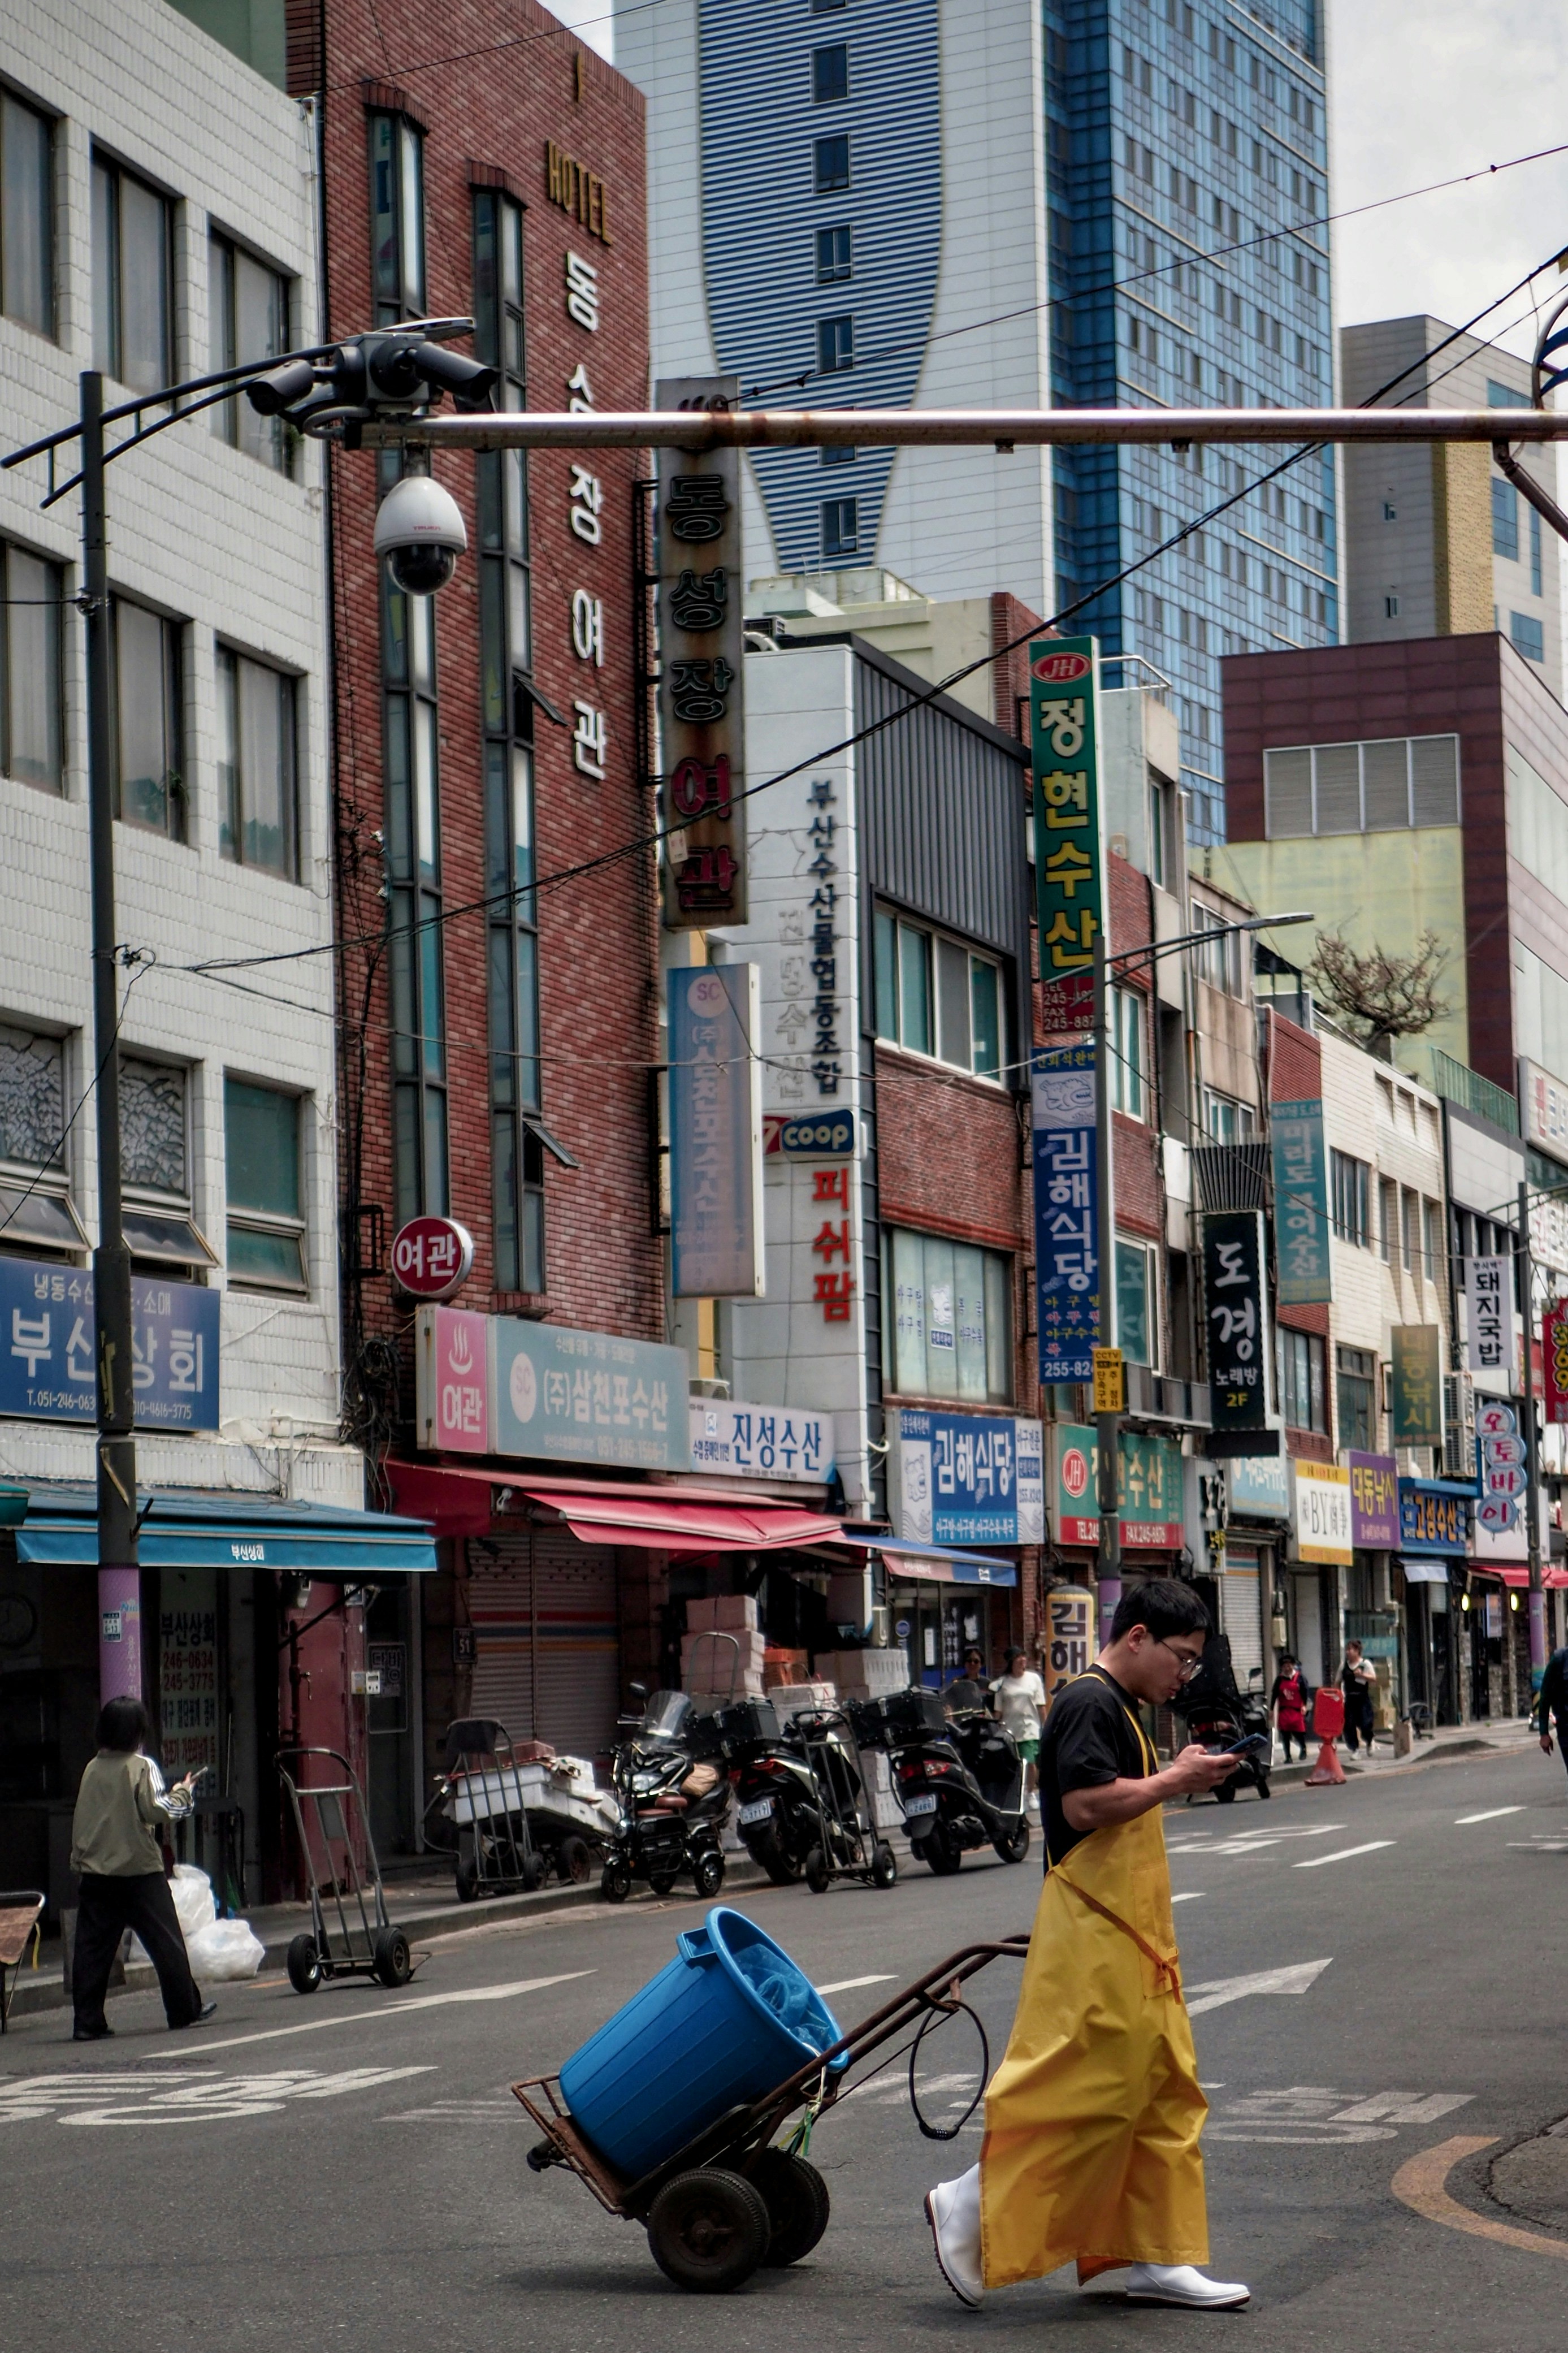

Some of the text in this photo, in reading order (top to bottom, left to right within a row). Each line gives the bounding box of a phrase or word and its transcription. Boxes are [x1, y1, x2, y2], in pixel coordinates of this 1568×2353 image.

[547, 139, 612, 246] HOTEL
[666, 474, 738, 909] 동성장여관
[1043, 658, 1078, 678] JH
[1040, 699, 1098, 968] 정현수산
[805, 780, 842, 1095] 부산수산물협동조합
[696, 981, 721, 1002] SC
[1043, 1007, 1066, 1017] FAX
[1044, 1015, 1095, 1030] 245-887
[784, 1124, 850, 1150] coop
[1047, 1131, 1098, 1291] 김해식당
[396, 1233, 456, 1278] 여관
[812, 1168, 856, 1322] 피쉬팜
[1210, 1243, 1255, 1360] 도경
[1475, 1271, 1504, 1365] 돼지국밥
[1045, 1360, 1094, 1378] 255-82
[1216, 1366, 1258, 1386] 노래방
[27, 1389, 95, 1409] T.051-246-063
[442, 1383, 482, 1434] 여관
[544, 1368, 669, 1432] (주)삼천포수산
[1226, 1392, 1249, 1408] 2F
[731, 1413, 822, 1471] 진성수산
[935, 1429, 1011, 1496] 김해식당
[1481, 1412, 1520, 1524] 오토바이
[1067, 1460, 1082, 1487] JH
[1352, 1465, 1397, 1517] 대동낚시
